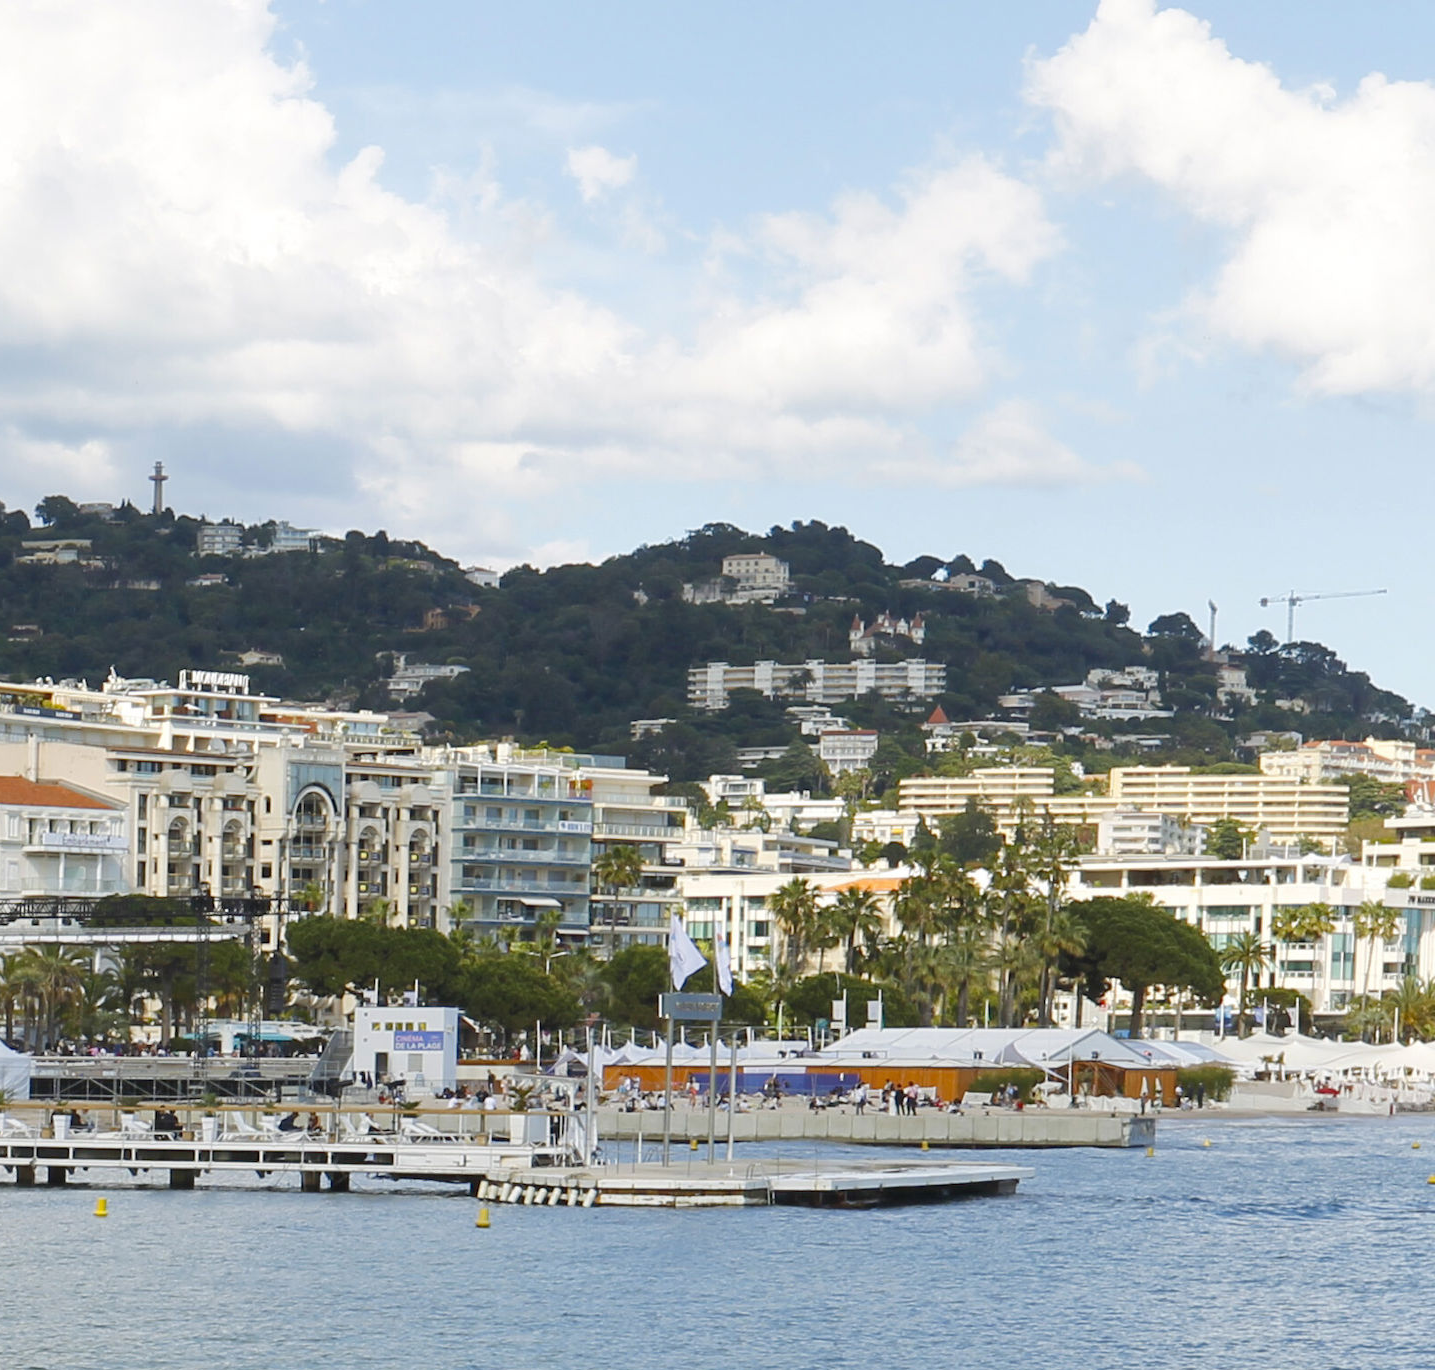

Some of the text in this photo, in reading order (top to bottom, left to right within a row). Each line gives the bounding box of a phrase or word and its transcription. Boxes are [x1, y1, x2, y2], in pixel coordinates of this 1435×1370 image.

[395, 1042, 441, 1050] DE LA PLAGE
